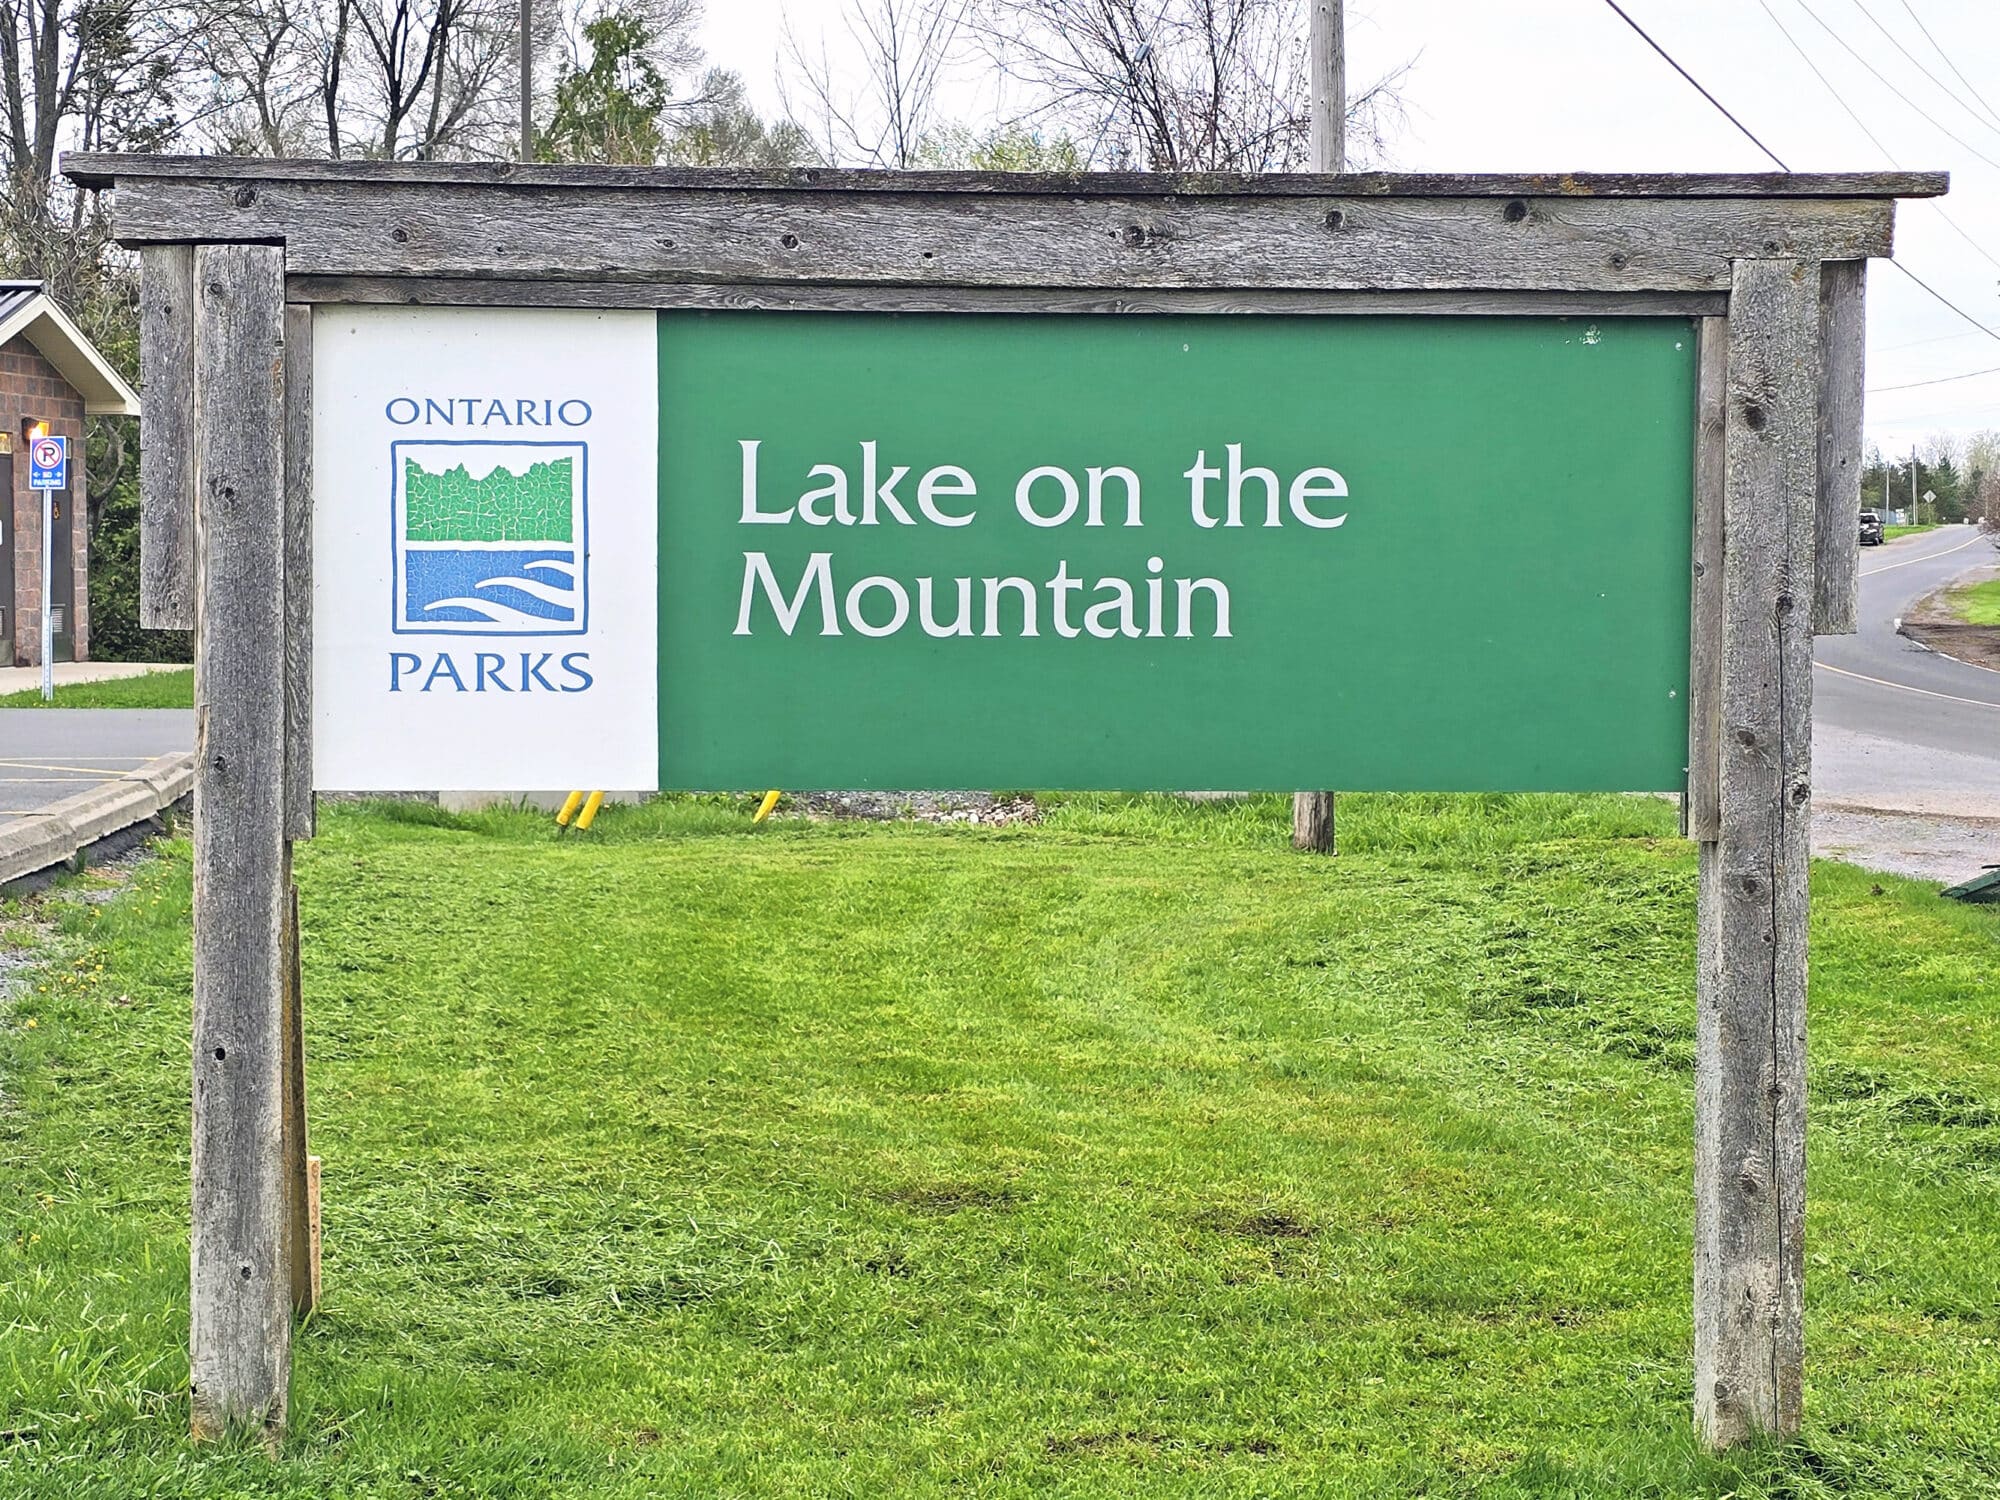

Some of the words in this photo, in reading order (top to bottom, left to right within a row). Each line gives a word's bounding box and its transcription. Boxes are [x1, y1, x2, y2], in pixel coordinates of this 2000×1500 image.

[385, 397, 592, 426] ONTARIO
[737, 439, 977, 526] Lake
[1014, 465, 1144, 528] on
[1183, 442, 1349, 529] the
[732, 551, 1234, 639] Mountain
[388, 652, 594, 693] PARKS
